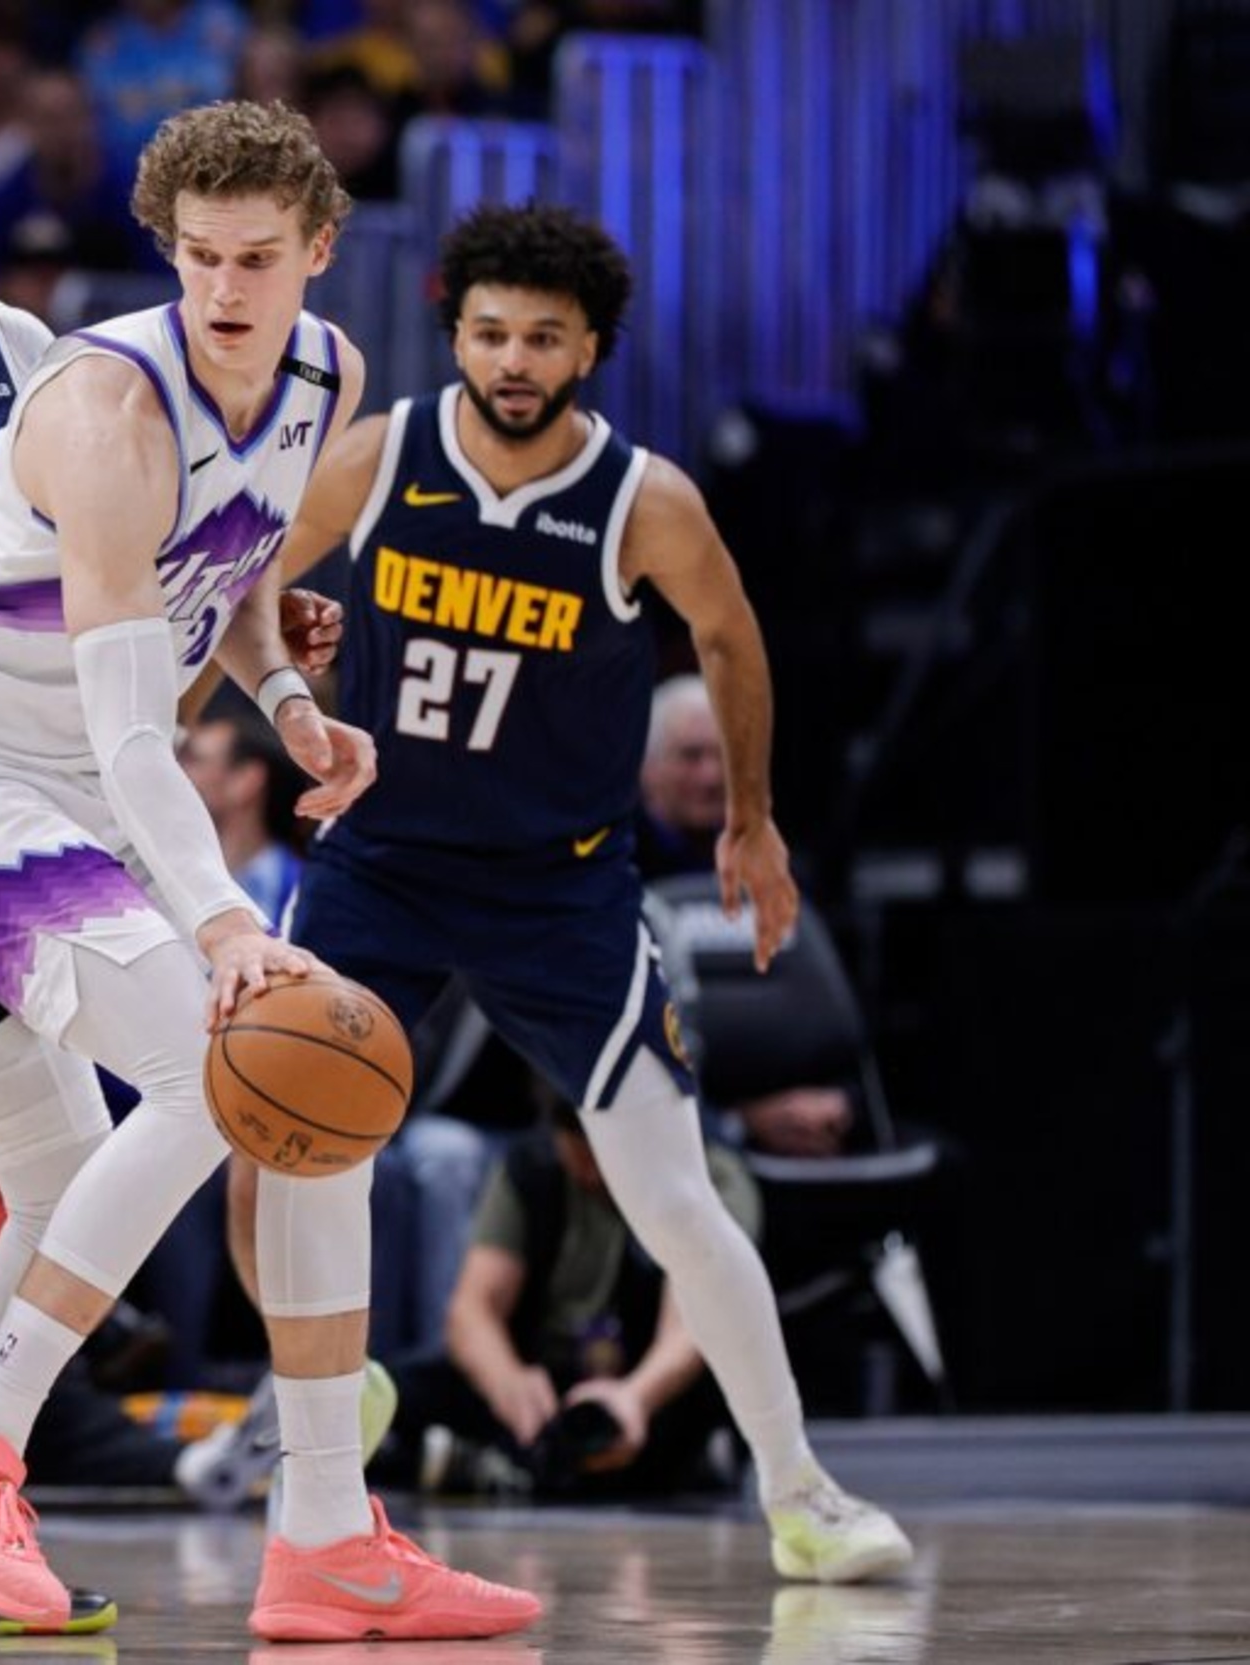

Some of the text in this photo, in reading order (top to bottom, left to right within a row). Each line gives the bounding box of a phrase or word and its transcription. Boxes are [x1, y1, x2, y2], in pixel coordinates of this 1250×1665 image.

[535, 511, 597, 545] ibotta
[374, 546, 584, 651] DENVER
[396, 636, 522, 751] 27
